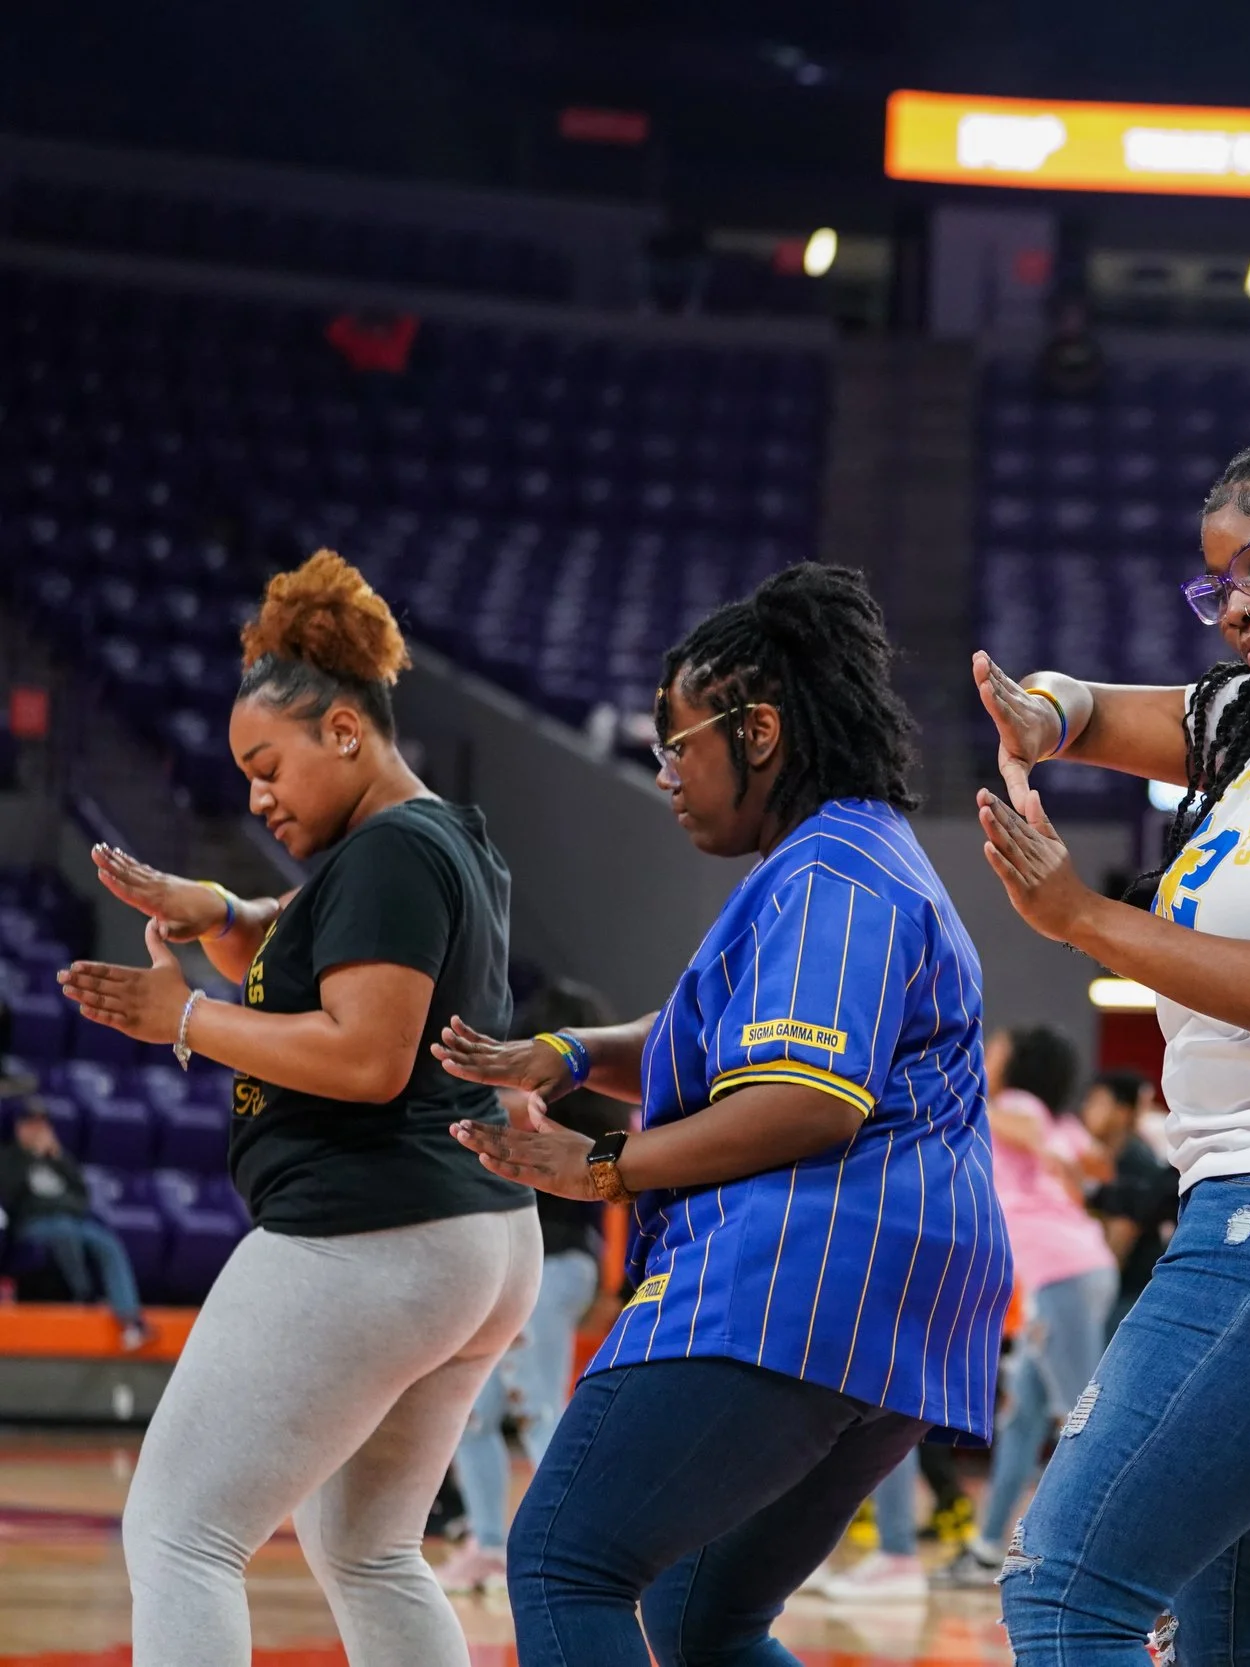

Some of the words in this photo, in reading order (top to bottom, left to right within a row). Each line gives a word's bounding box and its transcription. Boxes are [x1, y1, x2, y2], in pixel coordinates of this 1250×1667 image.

[749, 1025, 774, 1042] SIGMA
[776, 1023, 813, 1043] GAMMA
[816, 1031, 839, 1048] RHO
